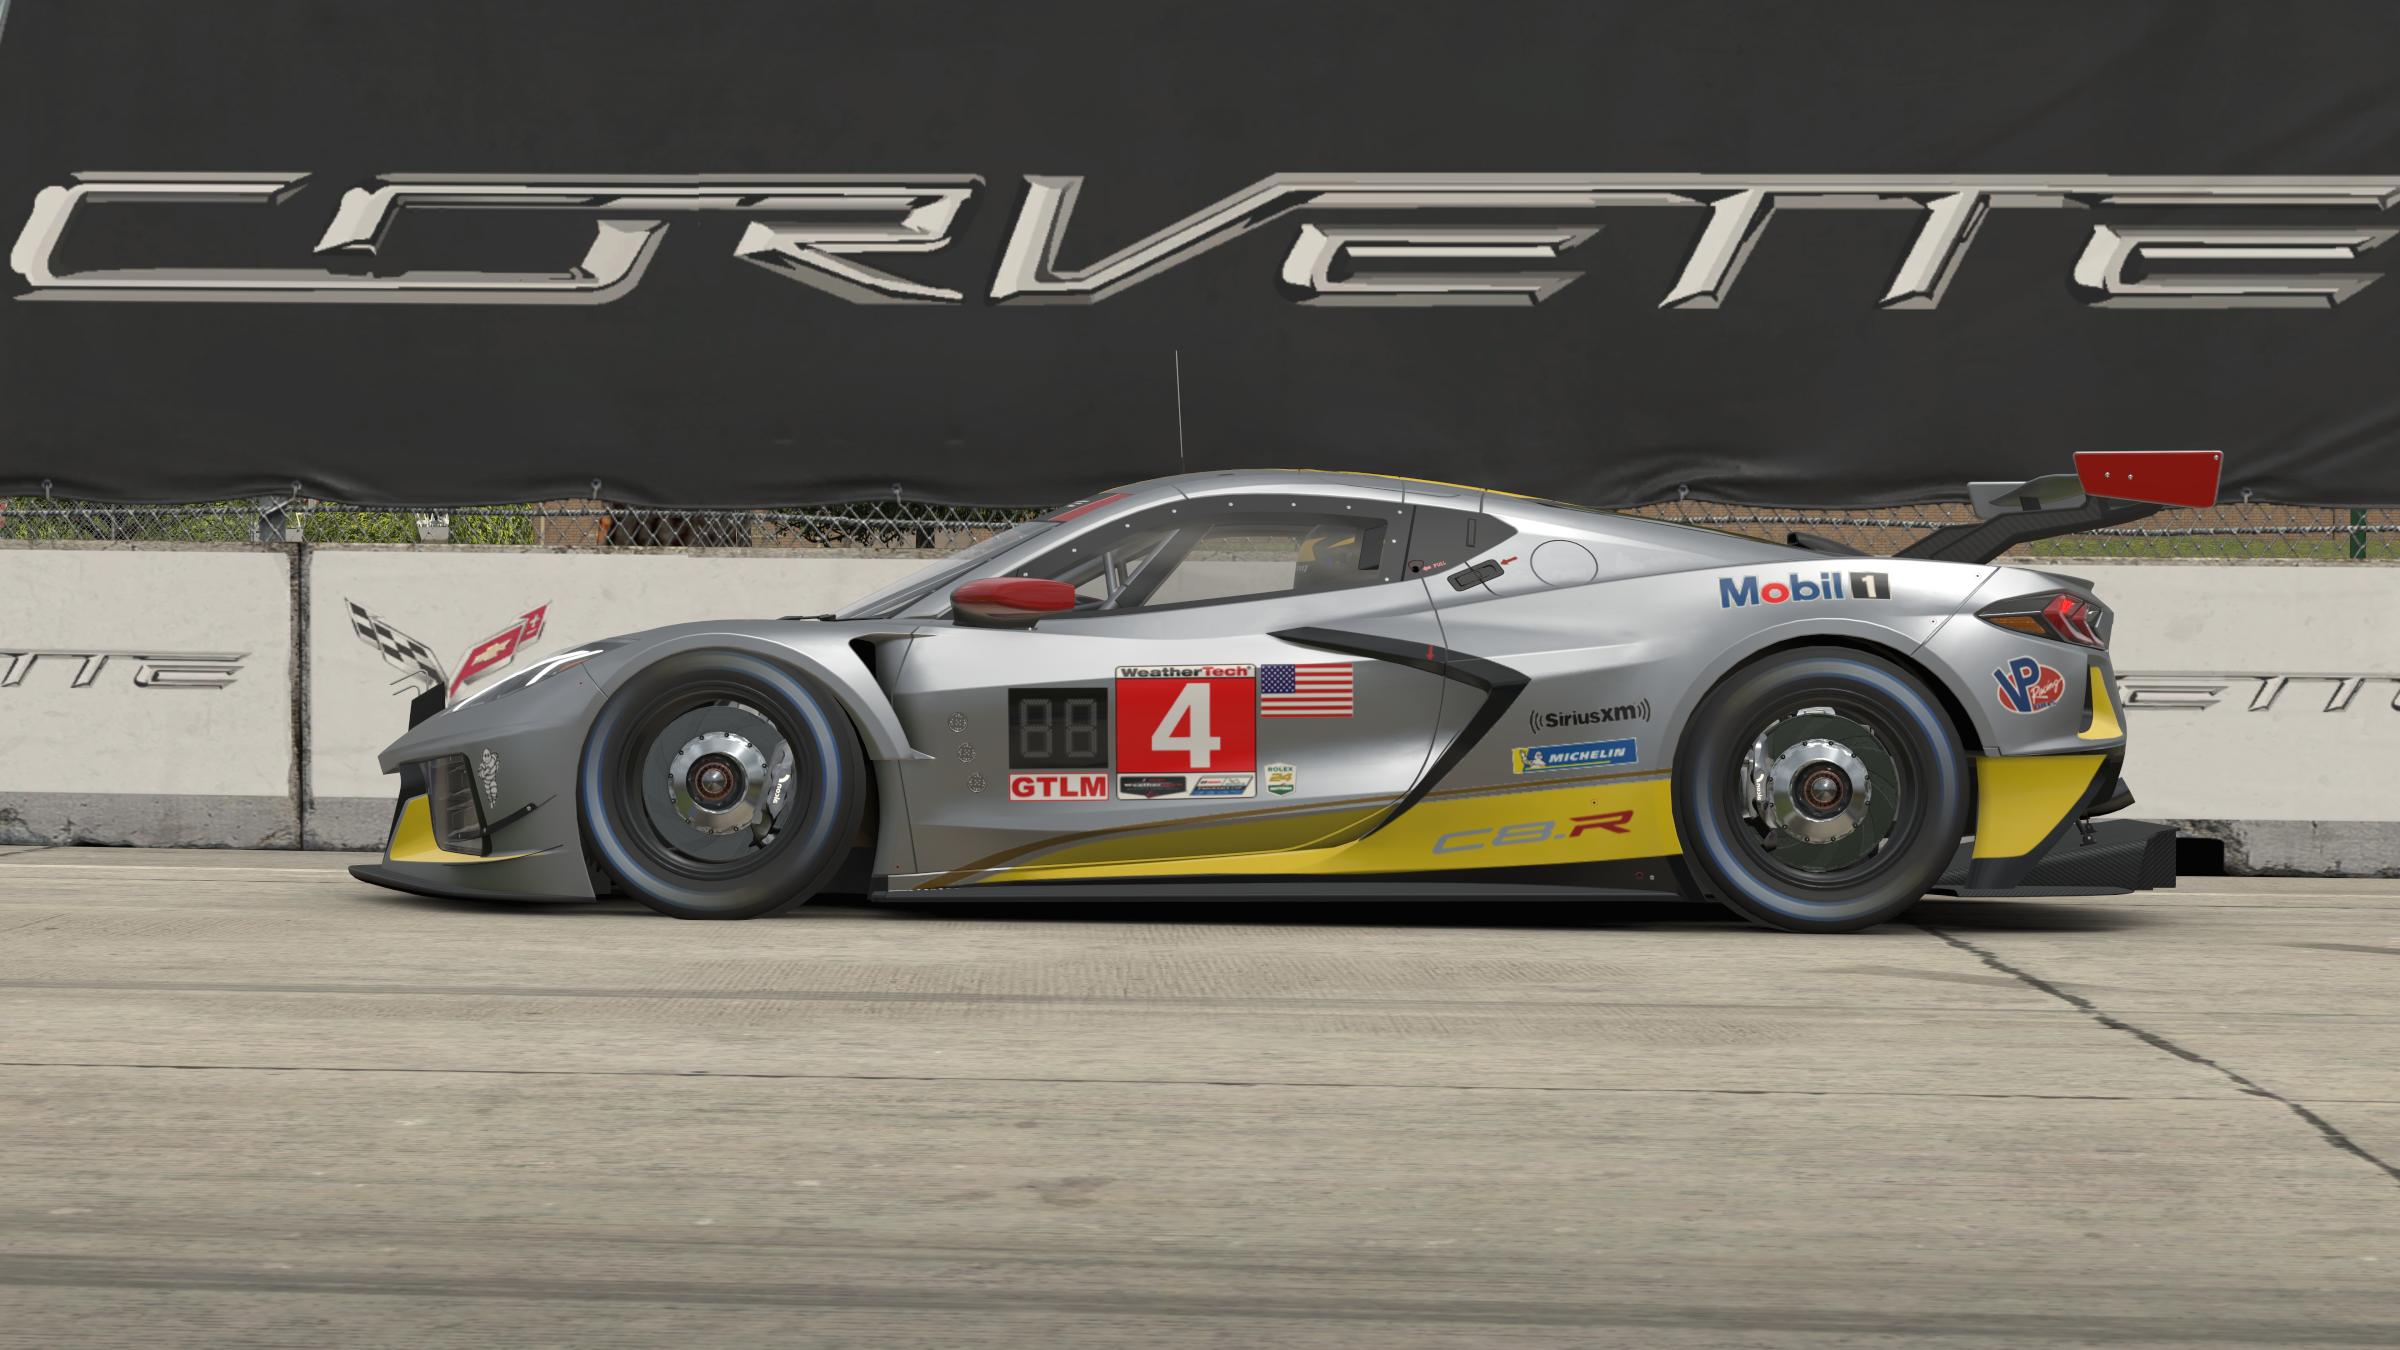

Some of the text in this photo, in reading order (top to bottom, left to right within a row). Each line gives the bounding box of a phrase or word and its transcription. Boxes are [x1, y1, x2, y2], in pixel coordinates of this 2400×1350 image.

[10, 171, 2399, 310] CORVETTE
[1719, 572, 1877, 608] Mobil 1
[1121, 666, 1248, 677] WeatherTech
[1993, 656, 2062, 713] VP Racing
[1151, 683, 1221, 768] 4
[1548, 747, 1626, 763] MICHELIN
[1011, 776, 1107, 797] GTLM
[1268, 773, 1293, 782] 24
[1432, 810, 1634, 855] C8.R
